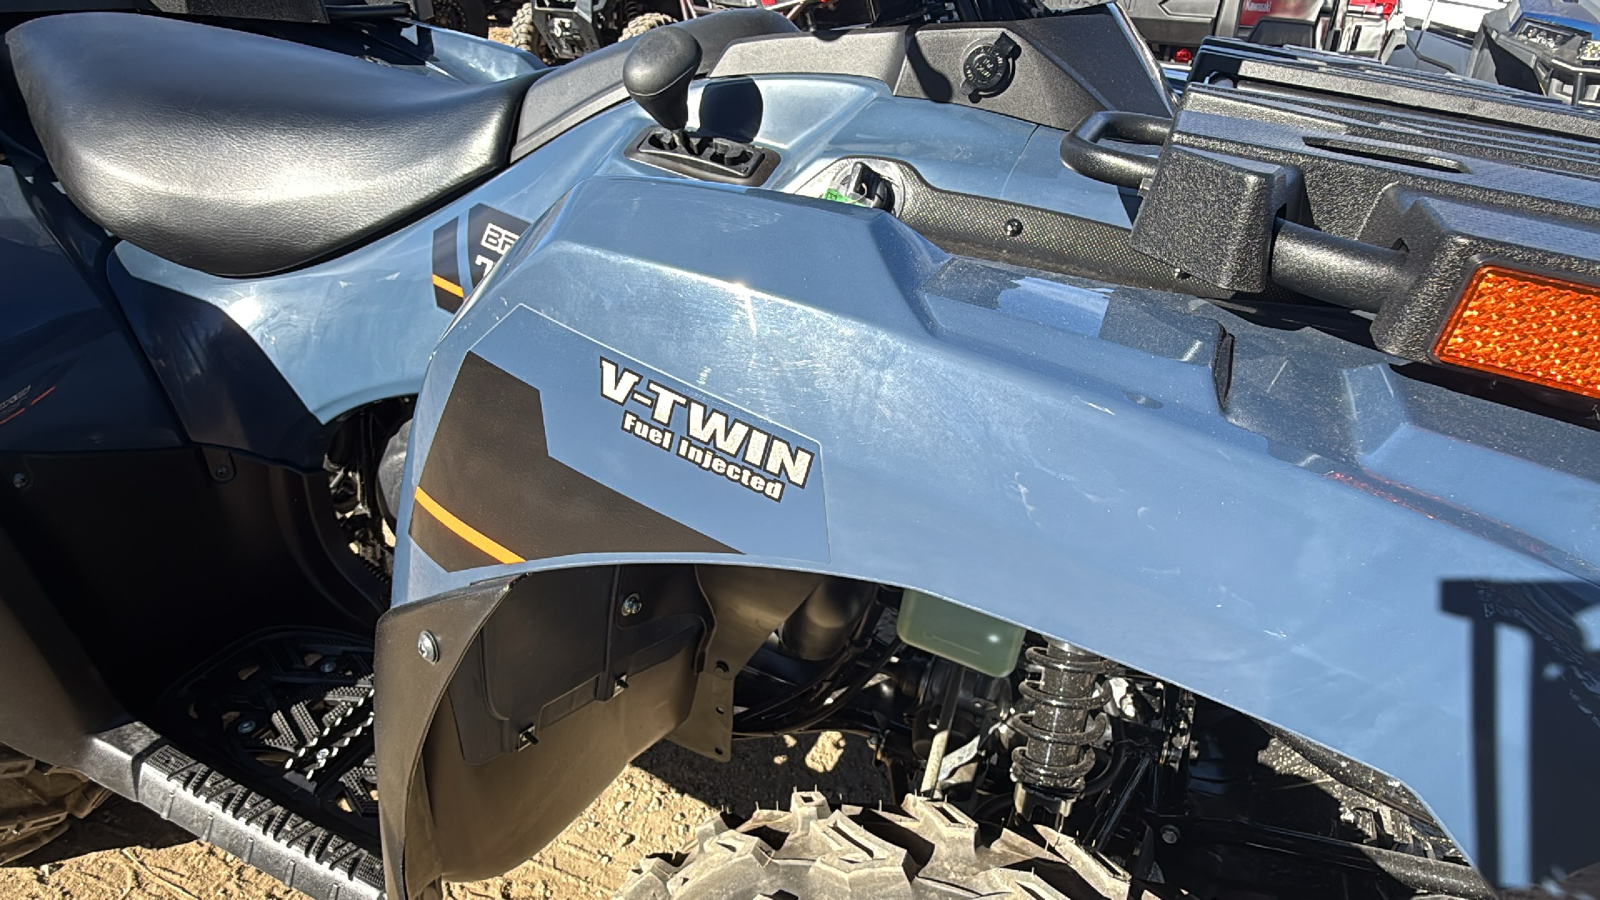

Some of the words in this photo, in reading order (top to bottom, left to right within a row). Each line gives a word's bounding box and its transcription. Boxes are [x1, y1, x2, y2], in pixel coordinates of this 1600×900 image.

[1244, 0, 1272, 12] Kawasaki
[600, 356, 815, 489] V-TWIN
[621, 410, 675, 452] Fuel
[676, 436, 786, 503] Injected
